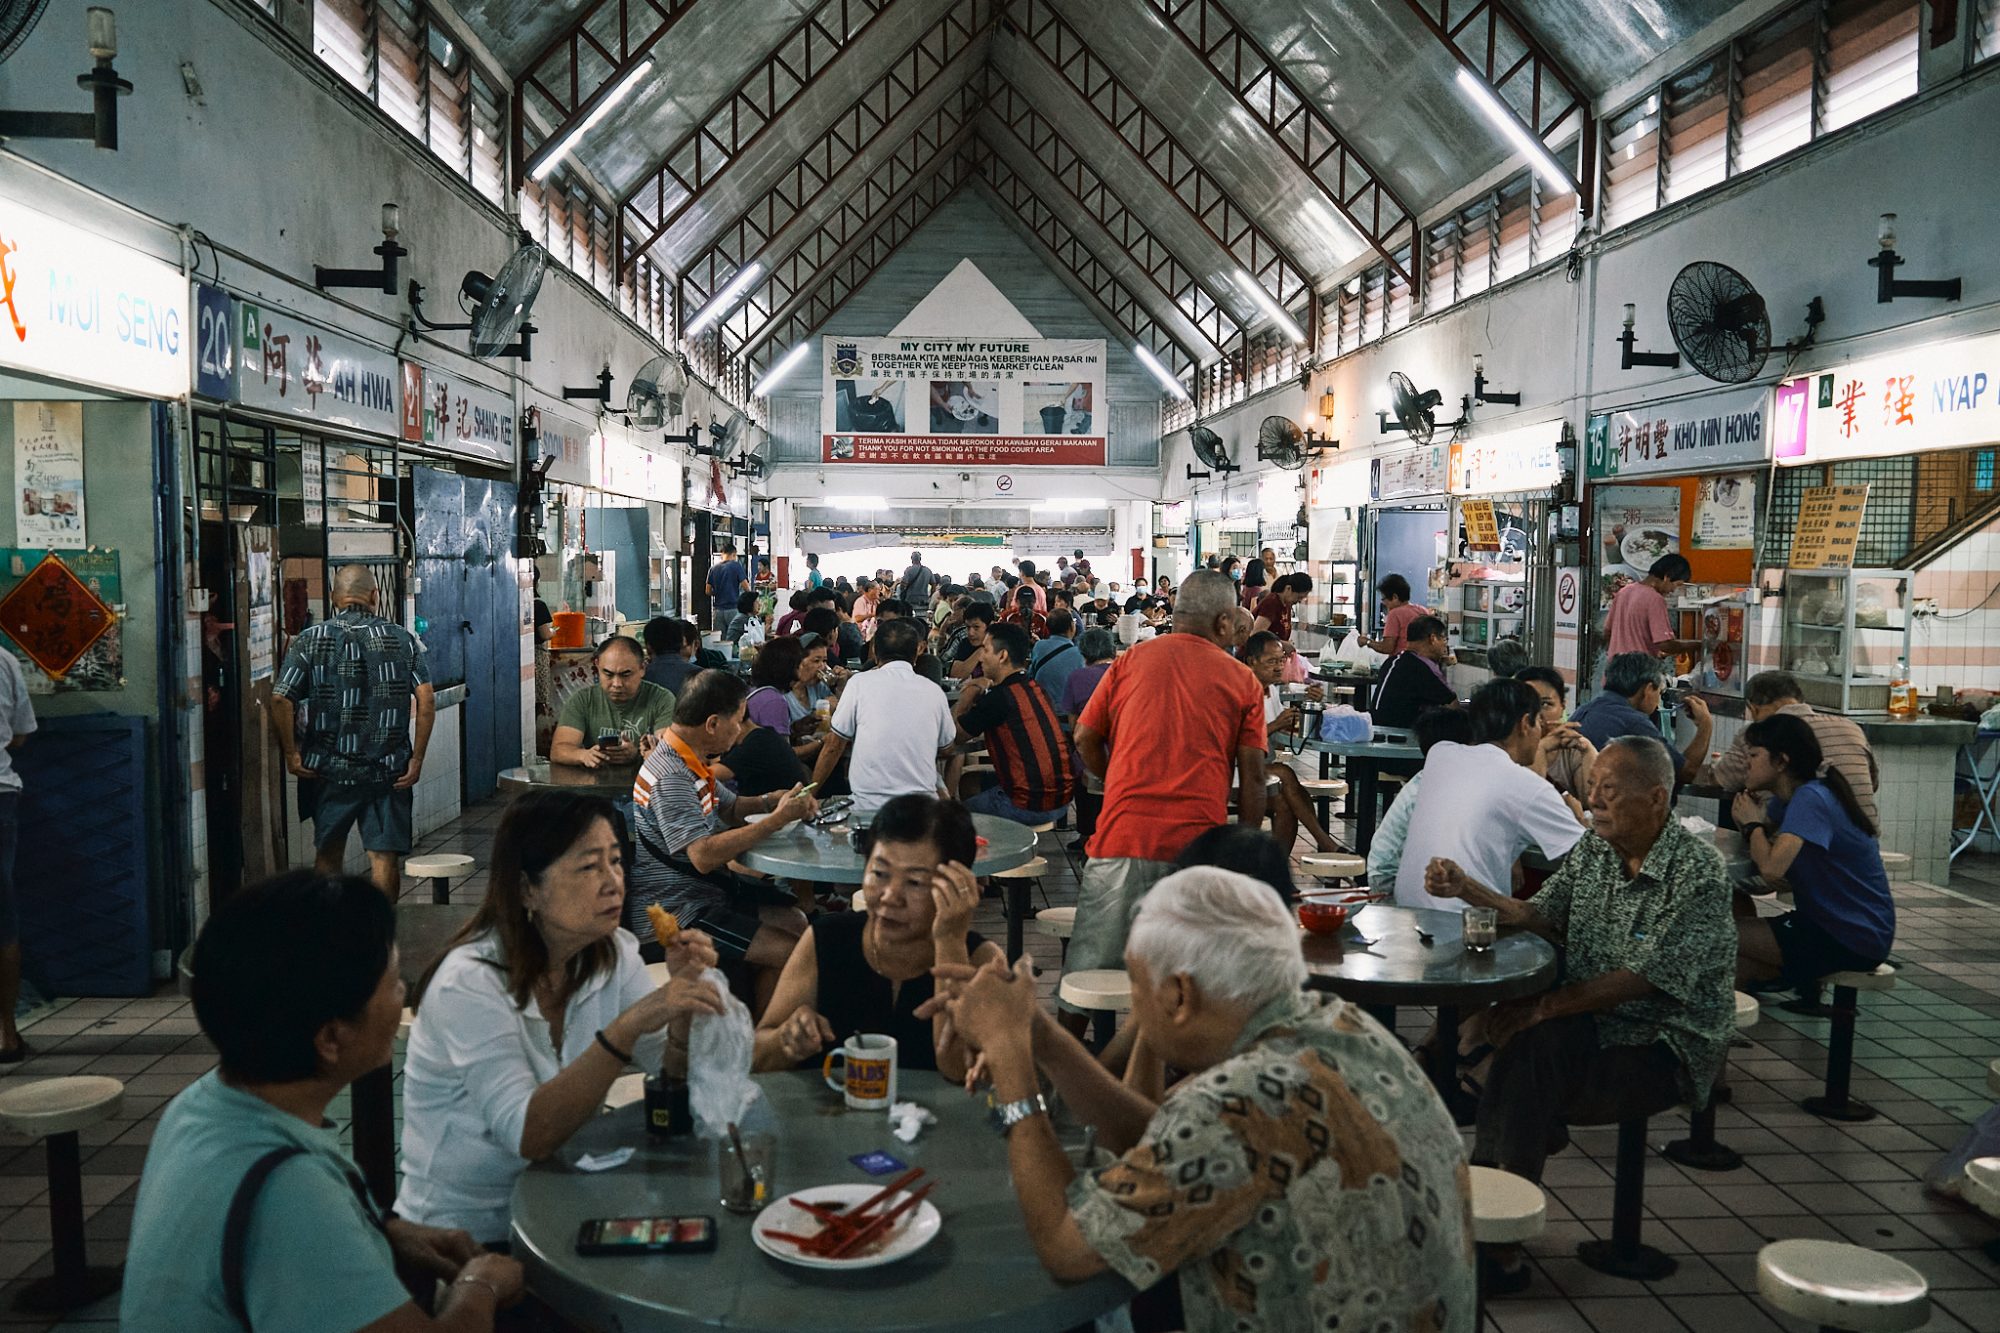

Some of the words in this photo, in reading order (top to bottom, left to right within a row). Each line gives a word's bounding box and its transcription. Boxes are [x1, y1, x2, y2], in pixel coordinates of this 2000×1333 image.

[49, 268, 99, 333] MUI
[117, 292, 178, 355] SENG
[246, 313, 257, 338] A
[202, 305, 230, 379] 20
[901, 343, 919, 351] MY
[924, 343, 952, 352] CITY
[957, 343, 976, 352] MY
[980, 344, 1030, 353] FUTURE
[871, 353, 917, 361] BERSAMA
[942, 354, 987, 362] MENJAGA
[990, 355, 1050, 363] KEBERSIHAN
[1052, 356, 1083, 364] PASAR
[1085, 356, 1098, 364] INI
[871, 361, 922, 369] TOGETHER
[941, 362, 967, 370] KEEP
[991, 363, 1030, 371] MARKET
[1033, 363, 1064, 371] CLEAN
[334, 371, 355, 404] AH
[362, 371, 394, 413] HWA
[404, 375, 420, 428] 21
[1821, 381, 1831, 400] A
[1932, 372, 1988, 414] NYAP
[426, 417, 433, 434] A
[500, 415, 511, 446] KEE
[1674, 422, 1697, 451] KHO
[1700, 418, 1722, 448] MIN
[1725, 411, 1761, 444] HONG
[1781, 393, 1805, 444] 17
[859, 437, 884, 445] TERIMA
[885, 437, 906, 445] KASIH
[1063, 439, 1097, 447] MAKANAN
[1590, 430, 1604, 466] 16
[1610, 452, 1617, 468] A
[1623, 508, 1641, 525] 粥
